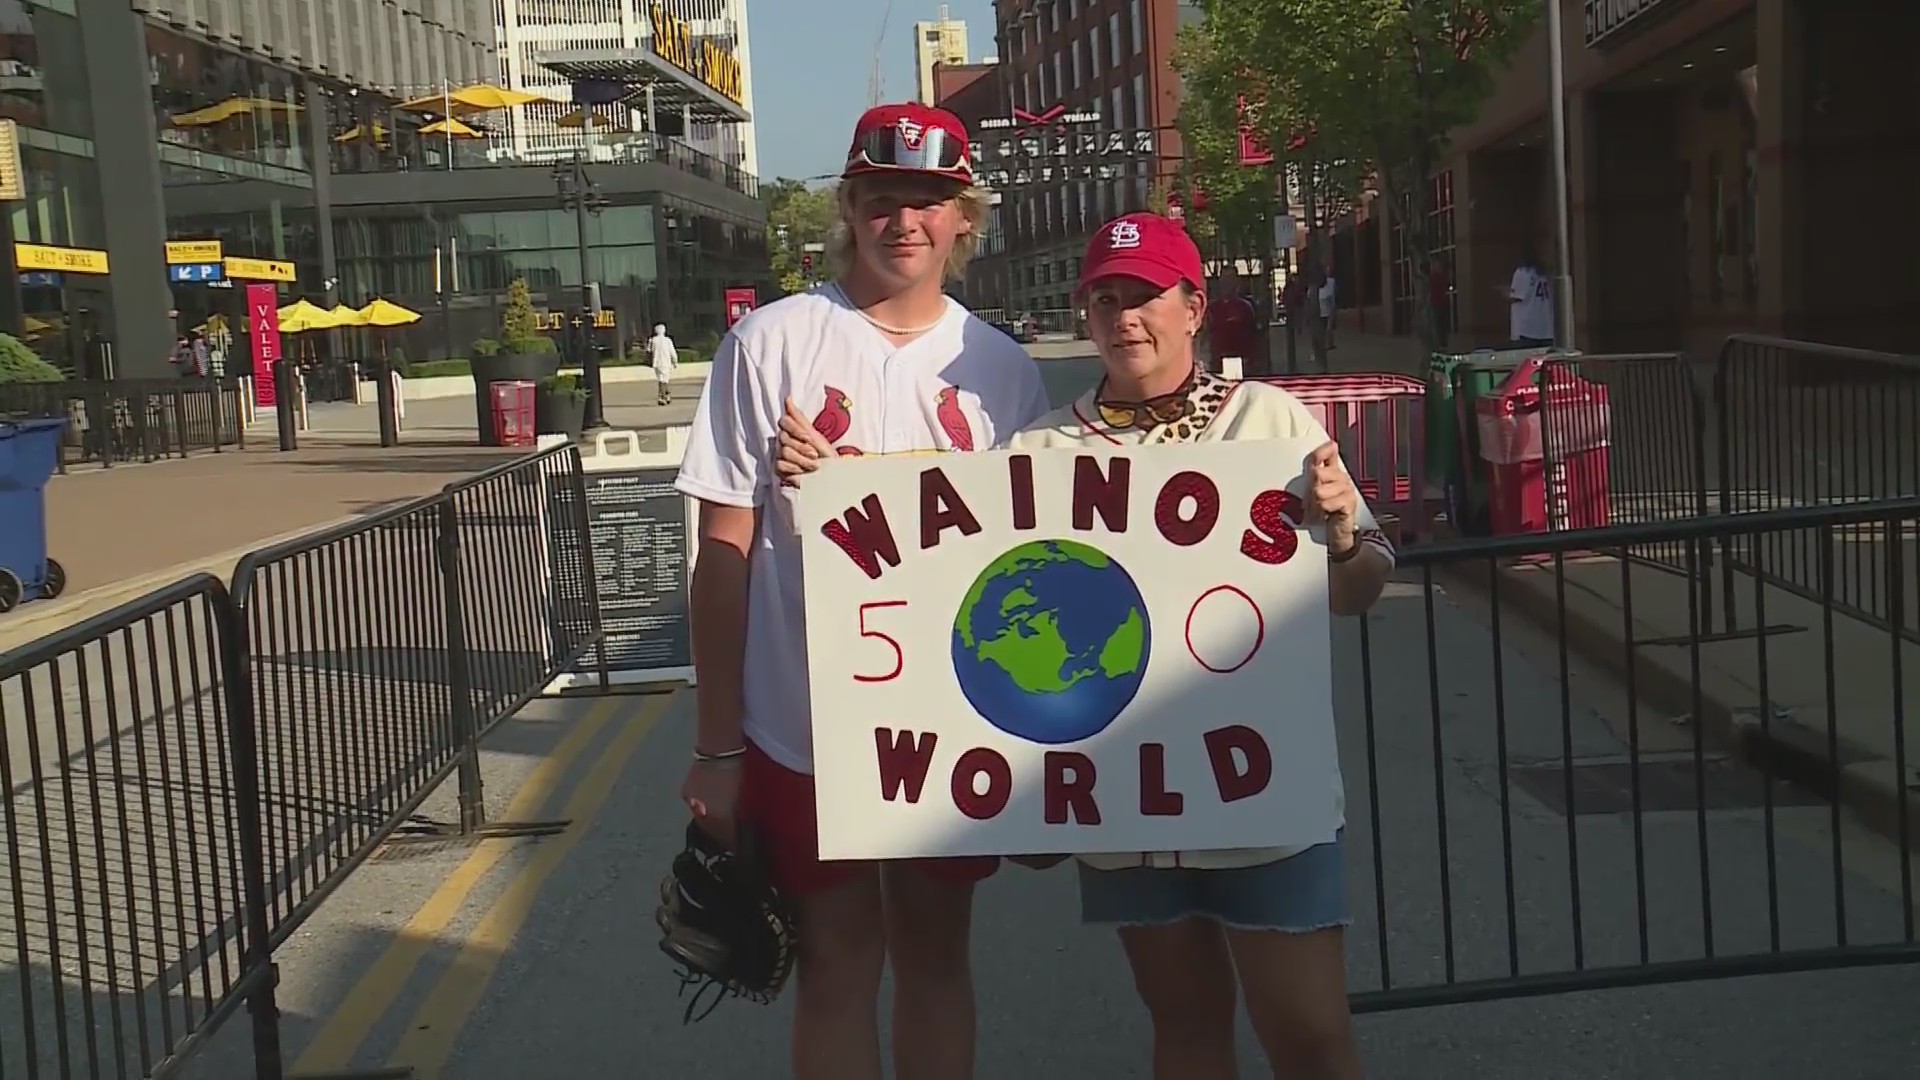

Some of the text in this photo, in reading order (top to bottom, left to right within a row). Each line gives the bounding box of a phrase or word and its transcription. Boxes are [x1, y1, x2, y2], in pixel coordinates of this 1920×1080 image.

[653, 4, 692, 72] SALT
[703, 39, 742, 106] SMOKE
[34, 250, 57, 264] SALT
[64, 253, 93, 267] SMOKE
[201, 264, 213, 279] P
[257, 304, 273, 372] VALET
[821, 454, 1304, 579] WAINOS
[853, 600, 908, 682] 5
[875, 724, 1273, 826] WORLD
